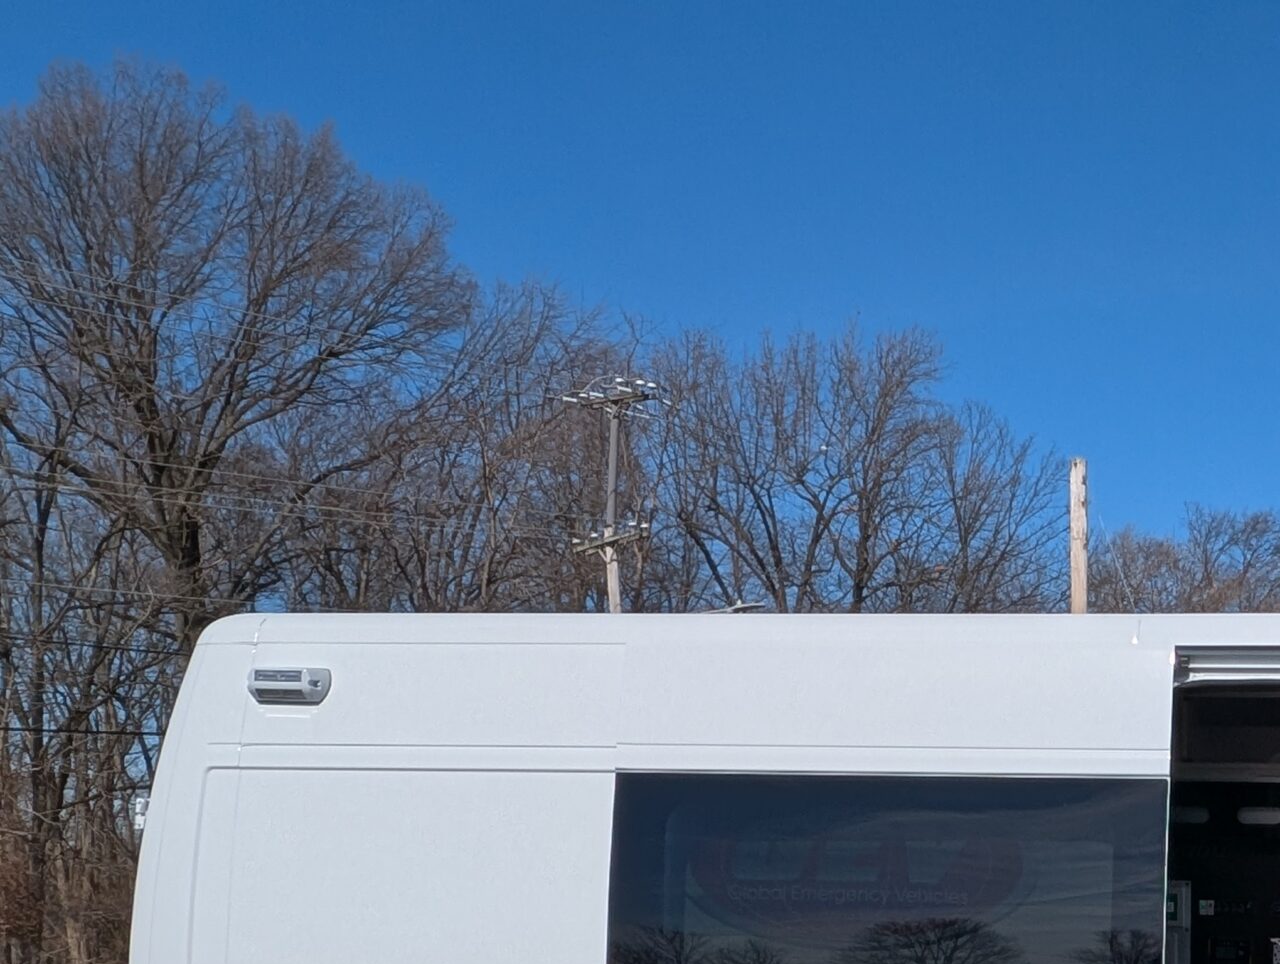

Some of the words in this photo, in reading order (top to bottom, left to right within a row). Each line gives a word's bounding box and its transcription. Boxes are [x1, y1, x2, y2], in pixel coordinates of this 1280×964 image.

[728, 884, 787, 902] Global
[791, 884, 891, 907] Emergency
[895, 886, 969, 904] Vehicles
